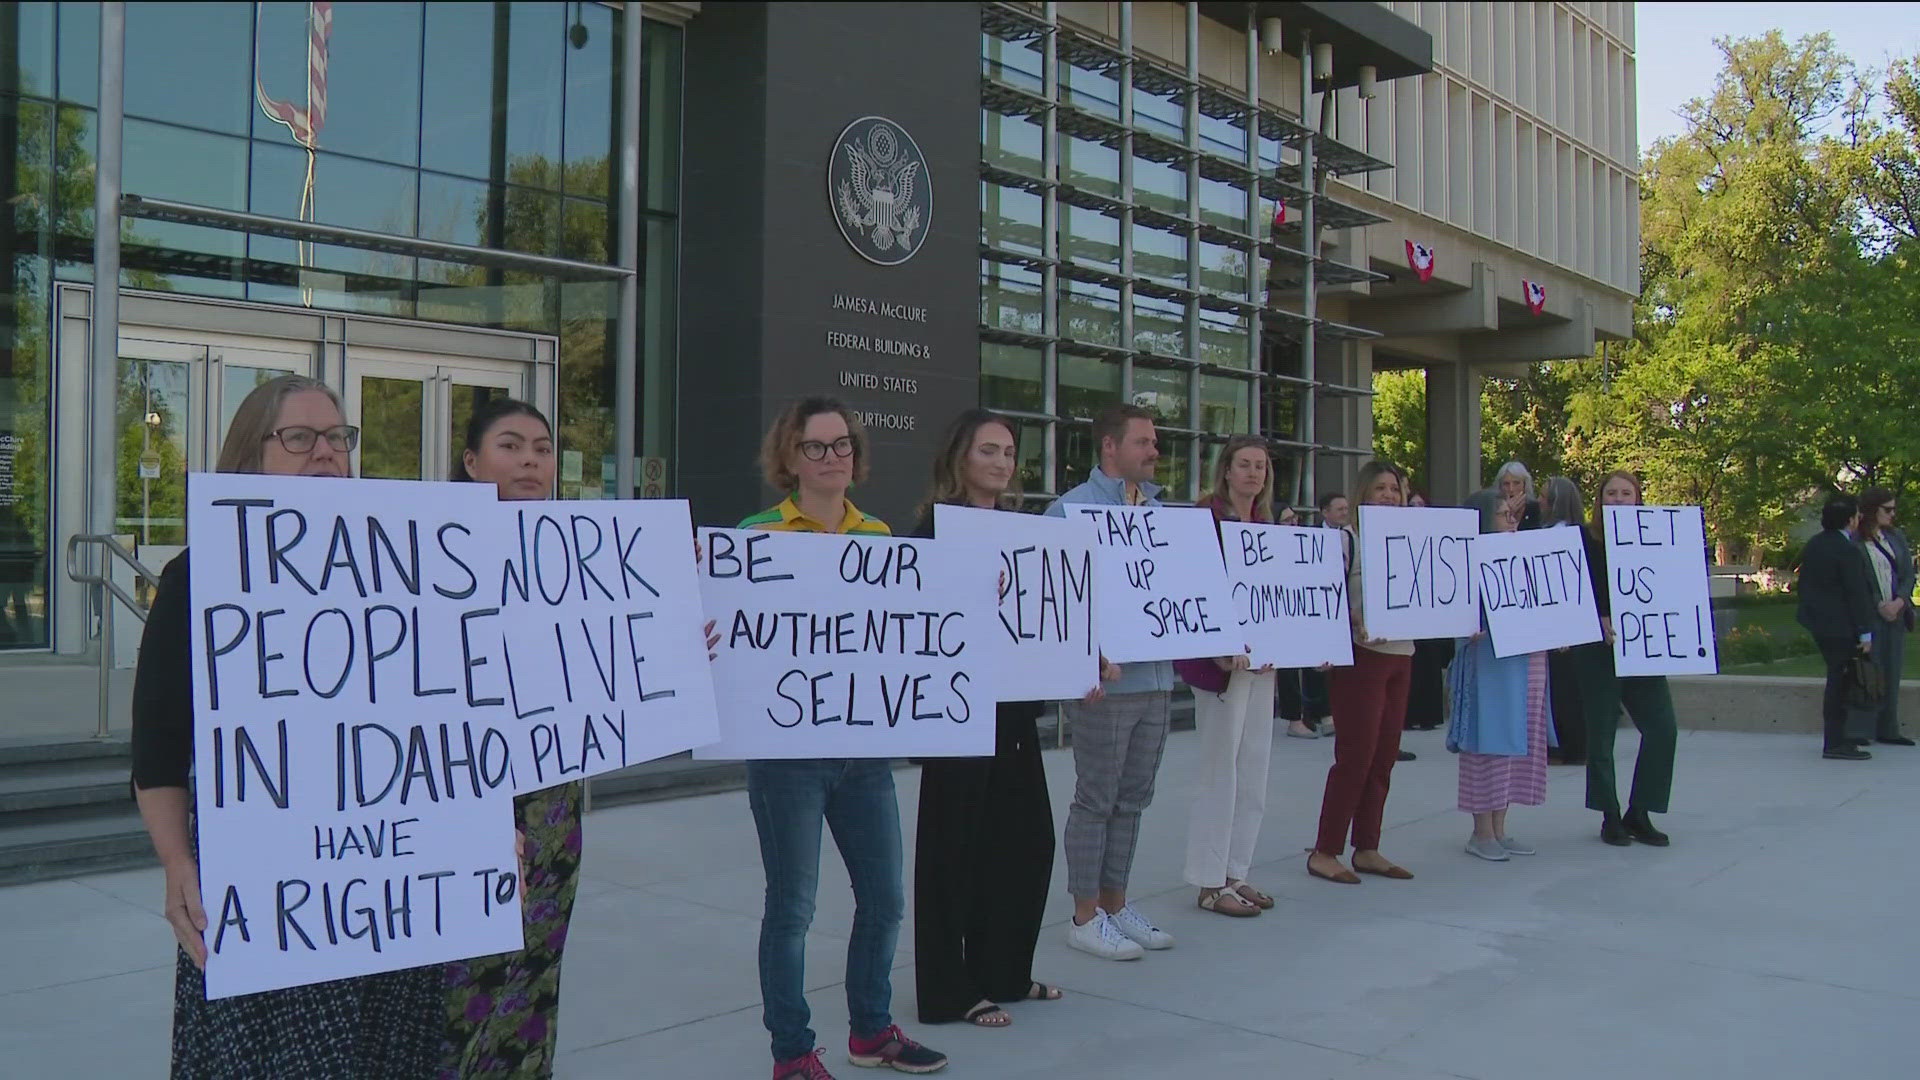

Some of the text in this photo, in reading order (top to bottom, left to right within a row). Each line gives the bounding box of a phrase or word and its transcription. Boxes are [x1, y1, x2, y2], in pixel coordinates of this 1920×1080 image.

[832, 293, 867, 314] JAMES
[880, 302, 927, 323] McCLURE
[827, 331, 930, 359] FEDERAL BUILDING &
[840, 371, 917, 394] UNITED STATES
[854, 410, 915, 430] OURTHOUSE
[212, 498, 478, 599] TRANS
[1081, 509, 1169, 552] TAKE
[1240, 529, 1324, 566] BE IN
[1613, 509, 1681, 546] LET
[708, 532, 921, 591] BE OUR
[1125, 559, 1155, 590] UP
[1386, 535, 1475, 610] EXIST
[1480, 549, 1582, 611] DIGNITY
[1618, 566, 1655, 603] US
[998, 545, 1091, 656] REAM
[1143, 597, 1221, 637] SPACE
[1232, 581, 1343, 626] COMMUNITY
[729, 609, 965, 657] AUTHENTIC
[1621, 605, 1706, 658] PEE!
[204, 603, 505, 711] PEOPLE
[502, 611, 676, 719] LIVE
[767, 669, 970, 728] SELVES
[214, 719, 510, 811] IN IDAHO
[530, 709, 627, 783] PLAY
[315, 818, 419, 860] HAVE
[214, 868, 516, 954] A RIGHT TO
